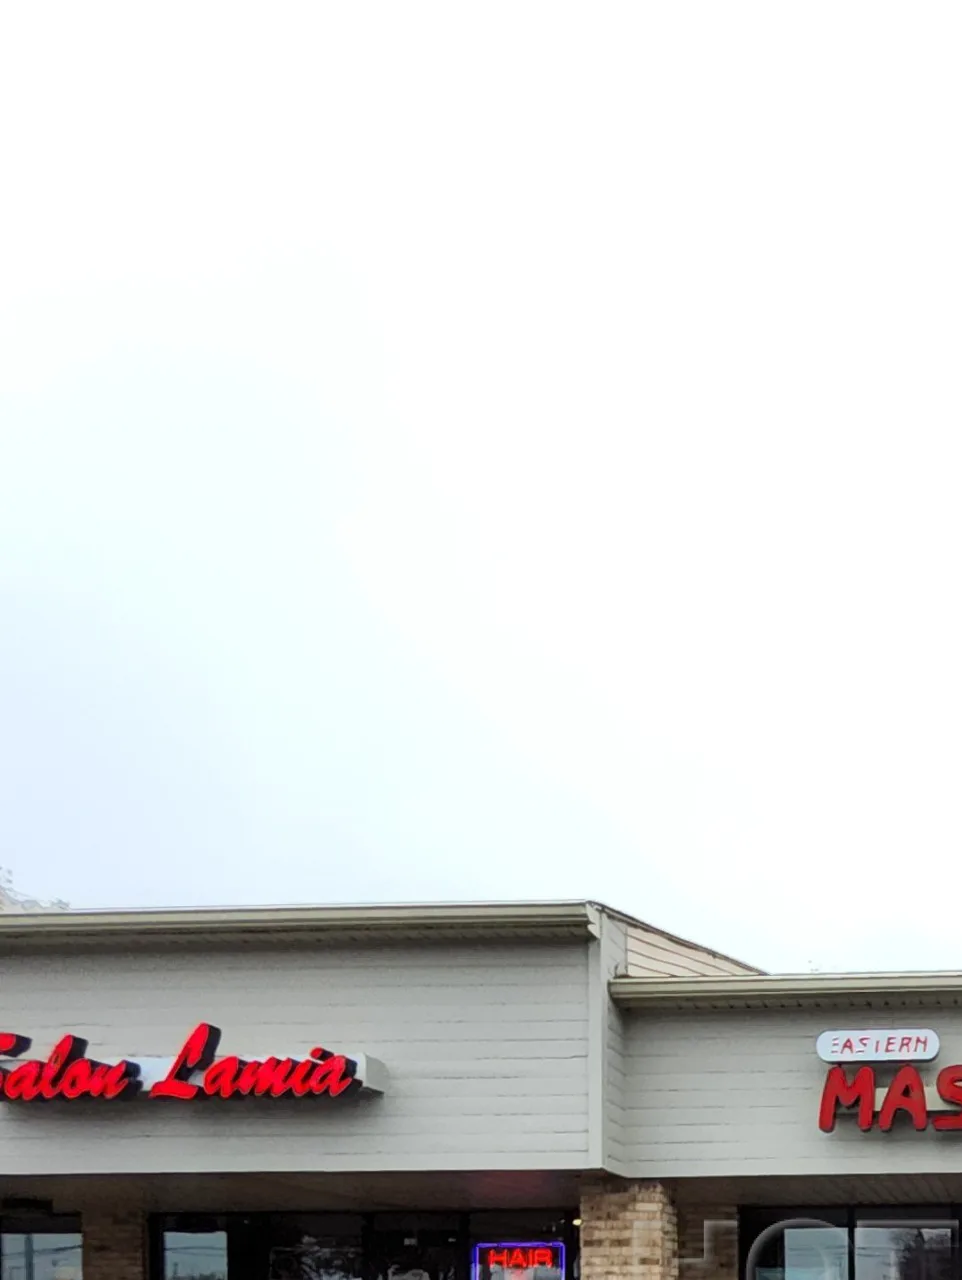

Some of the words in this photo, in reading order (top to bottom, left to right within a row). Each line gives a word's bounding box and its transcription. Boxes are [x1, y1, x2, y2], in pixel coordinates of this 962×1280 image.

[0, 1032, 130, 1100] alon
[151, 1022, 352, 1100] Lamia
[488, 1248, 553, 1268] HAIR
